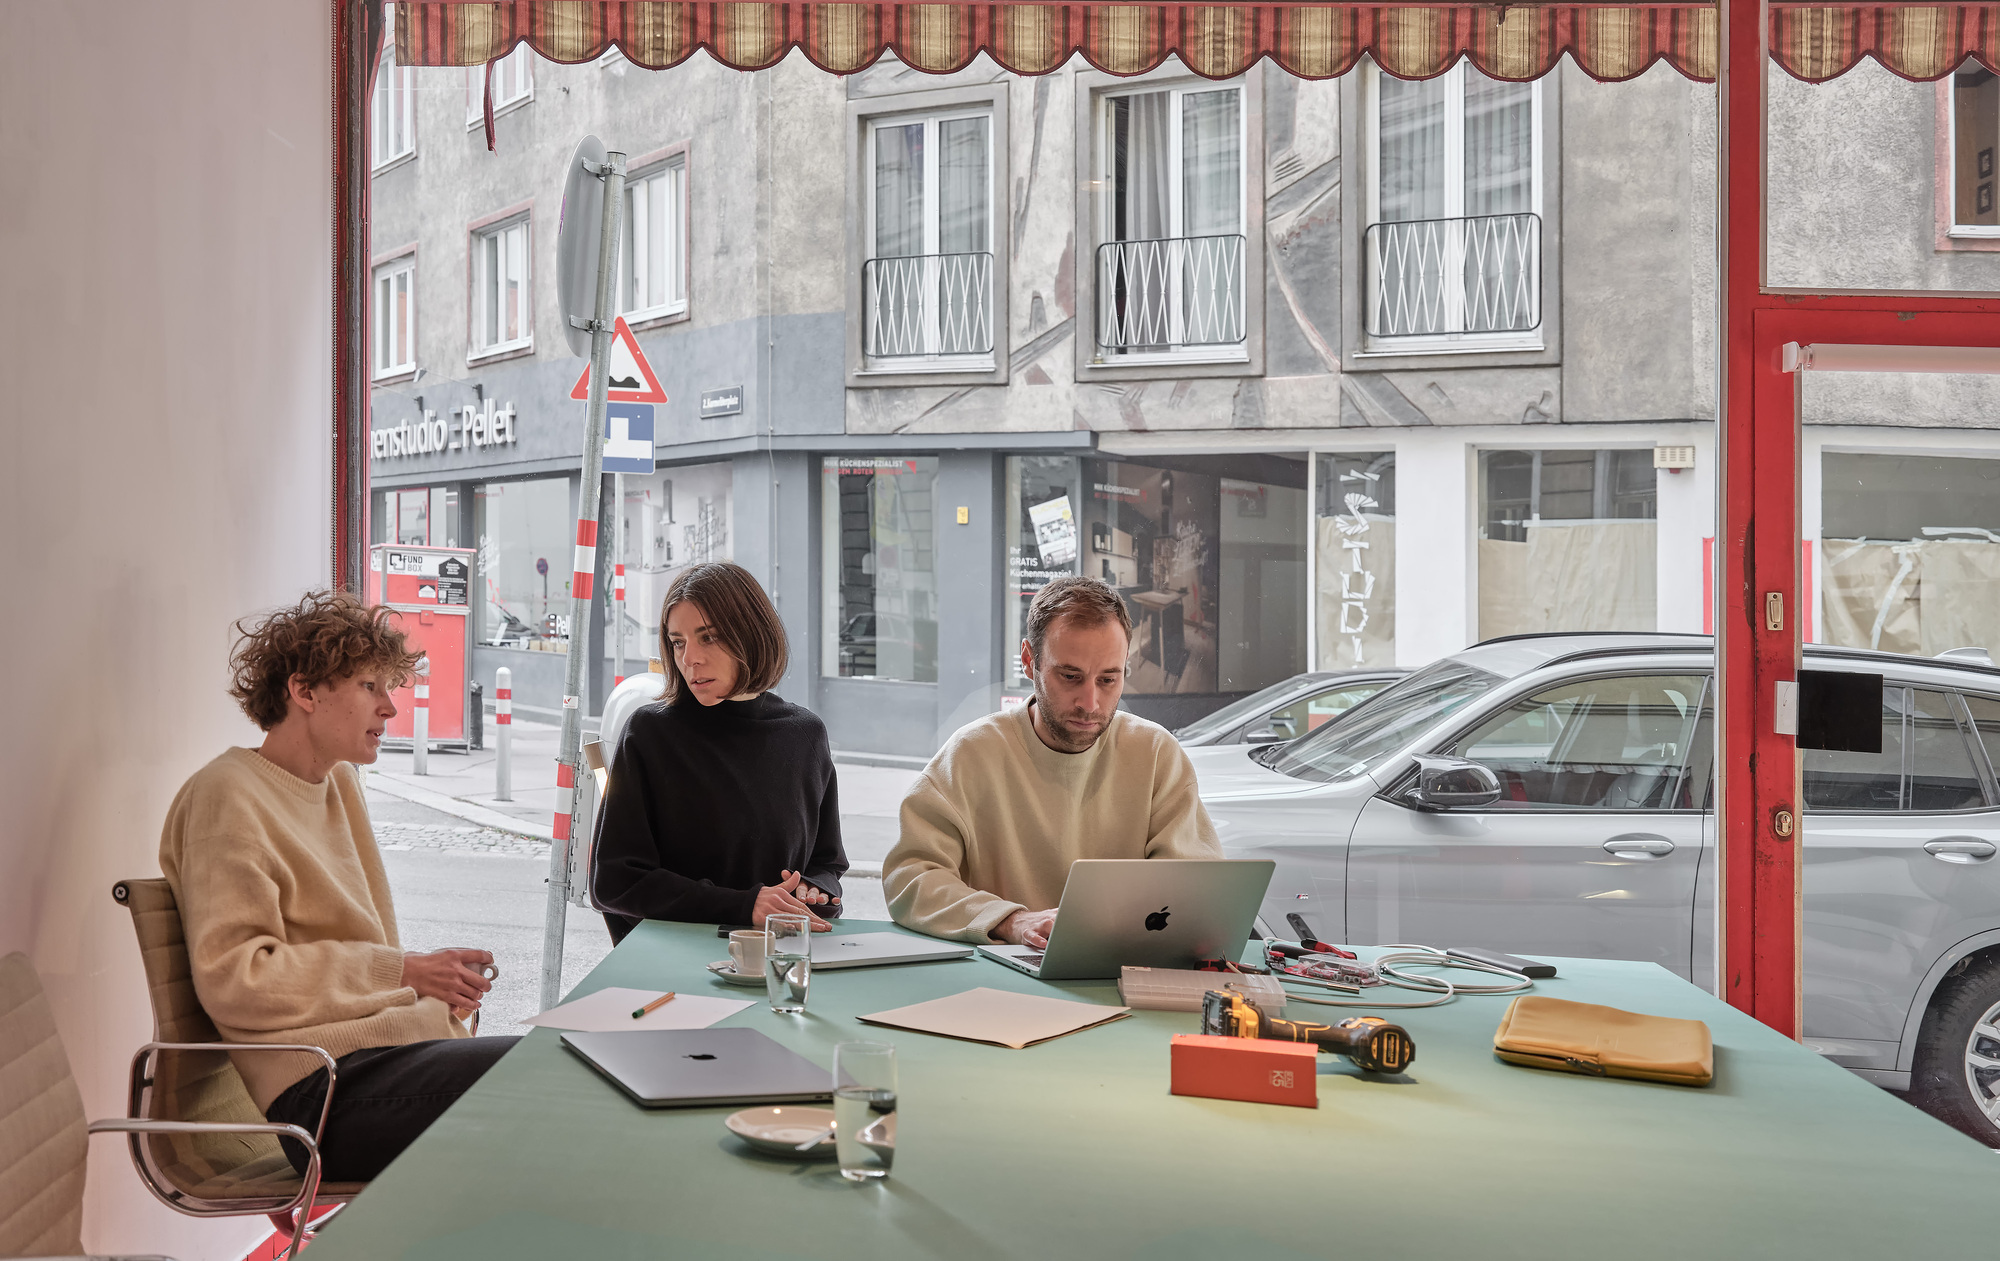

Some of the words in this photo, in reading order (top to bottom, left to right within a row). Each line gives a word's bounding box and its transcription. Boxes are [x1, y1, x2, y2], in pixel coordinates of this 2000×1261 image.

[462, 398, 516, 448] Pellet
[840, 458, 903, 467] KÜCHENSPEZIALIST
[403, 555, 423, 564] FUND
[1010, 557, 1038, 567] GRATIS
[407, 564, 423, 572] BOX
[1334, 492, 1380, 669] STUDI
[1272, 1070, 1285, 1087] K5
